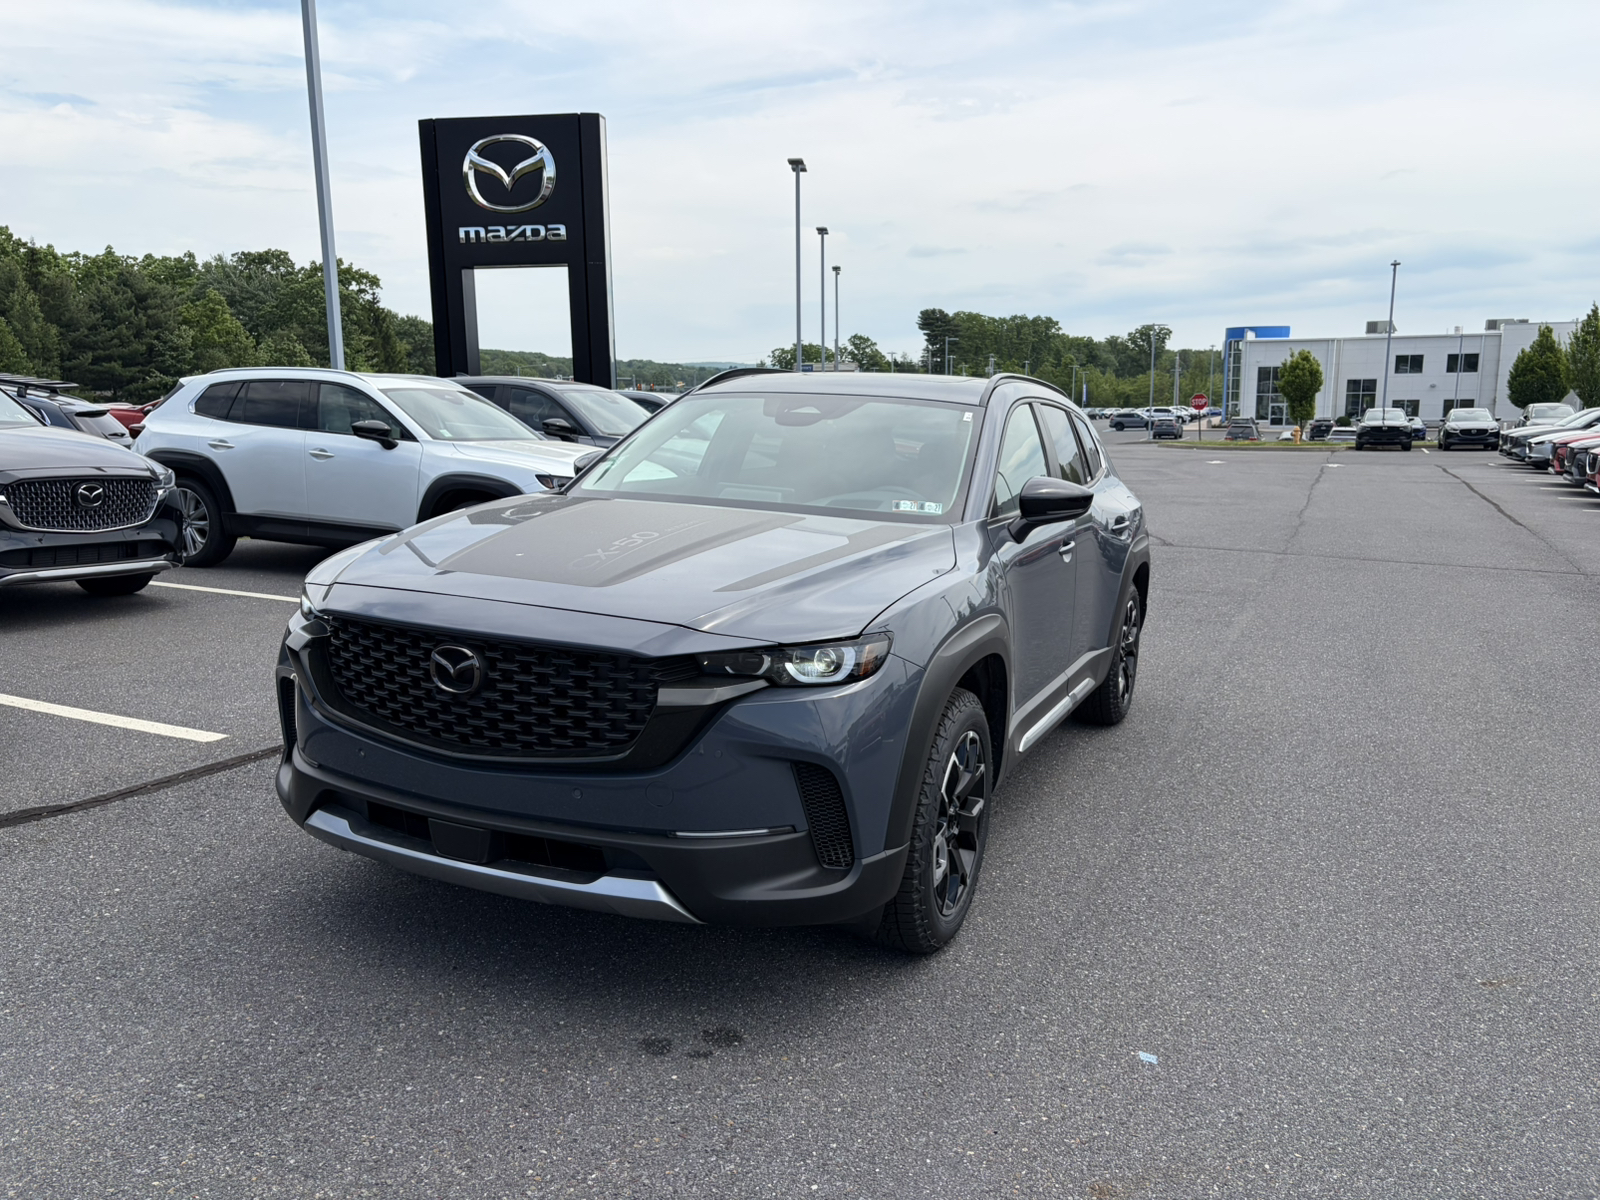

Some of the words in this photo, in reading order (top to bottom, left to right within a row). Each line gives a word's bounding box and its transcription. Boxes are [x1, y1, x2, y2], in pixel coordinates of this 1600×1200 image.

[459, 223, 567, 243] mazda
[1191, 398, 1207, 406] STOP
[568, 531, 660, 569] CX-50
